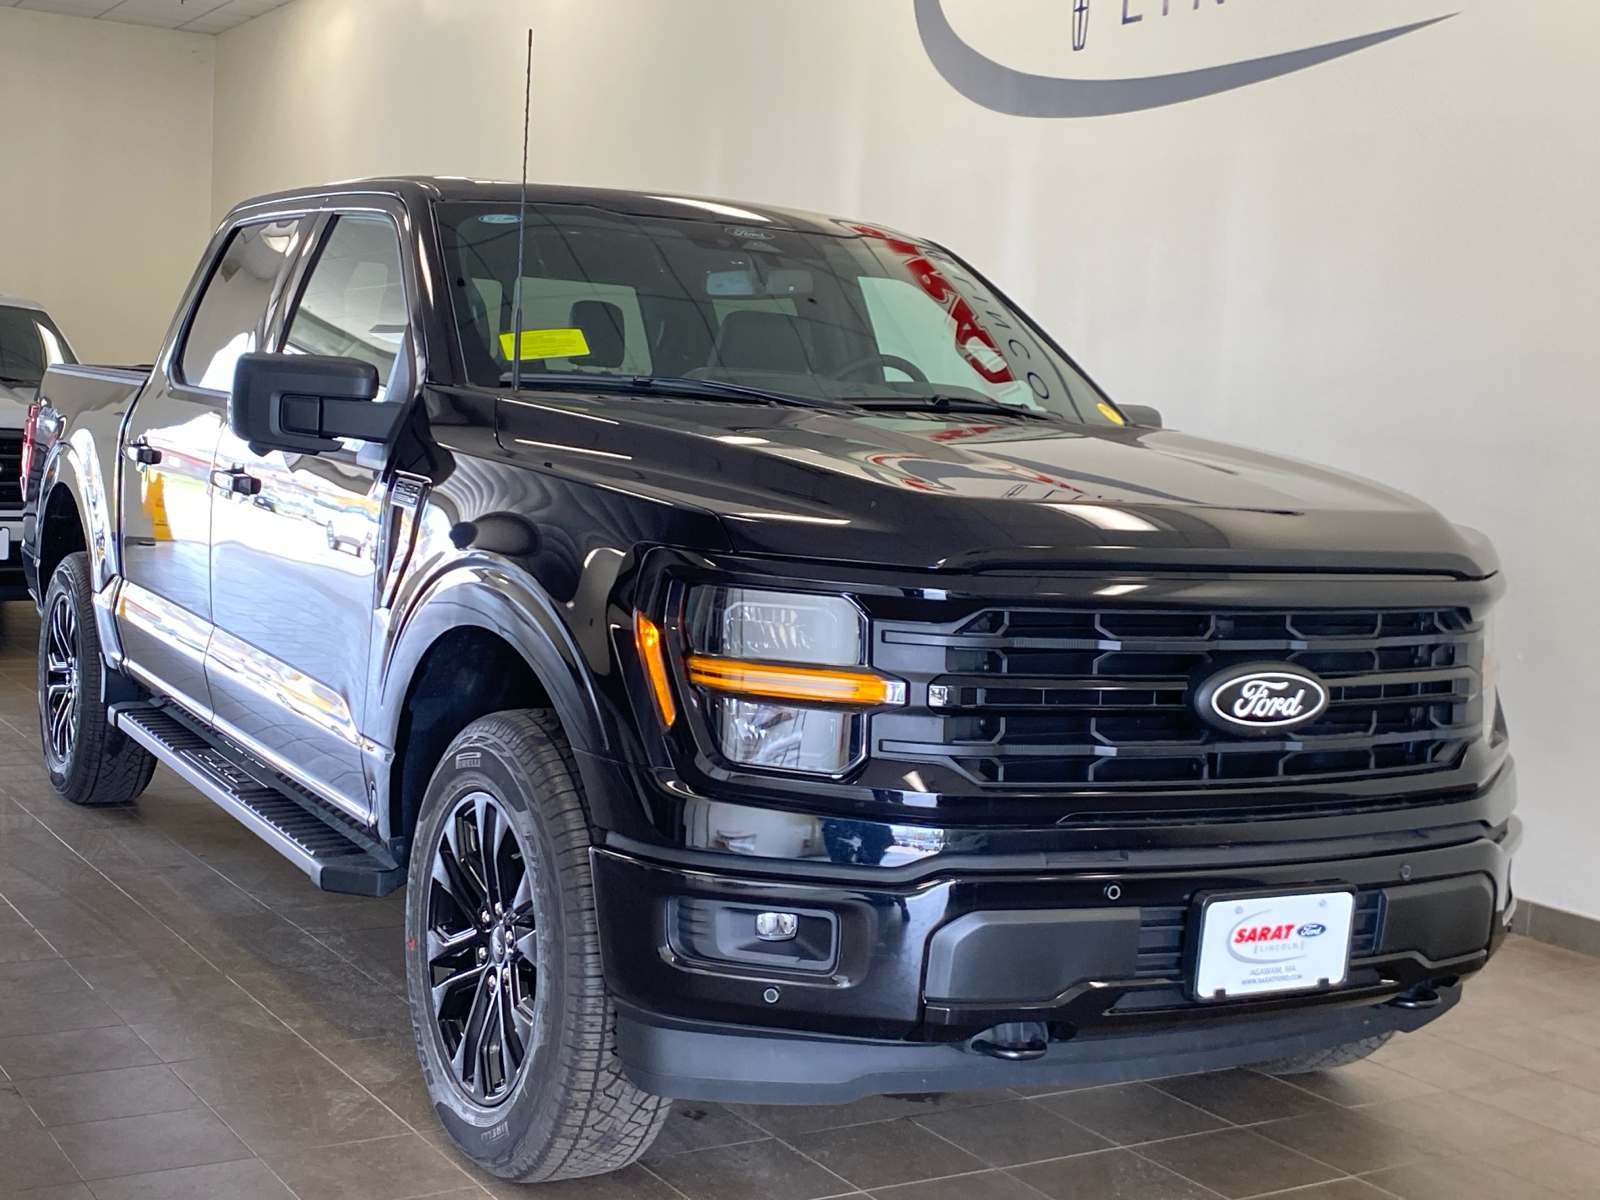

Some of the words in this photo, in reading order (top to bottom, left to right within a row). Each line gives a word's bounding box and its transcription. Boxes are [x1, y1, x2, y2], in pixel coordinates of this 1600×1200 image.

[1233, 680, 1306, 718] Ford
[455, 752, 482, 770] PIRELLI
[1233, 923, 1296, 944] SARAT
[1300, 924, 1323, 937] Ford
[1260, 942, 1299, 952] LINCOLN
